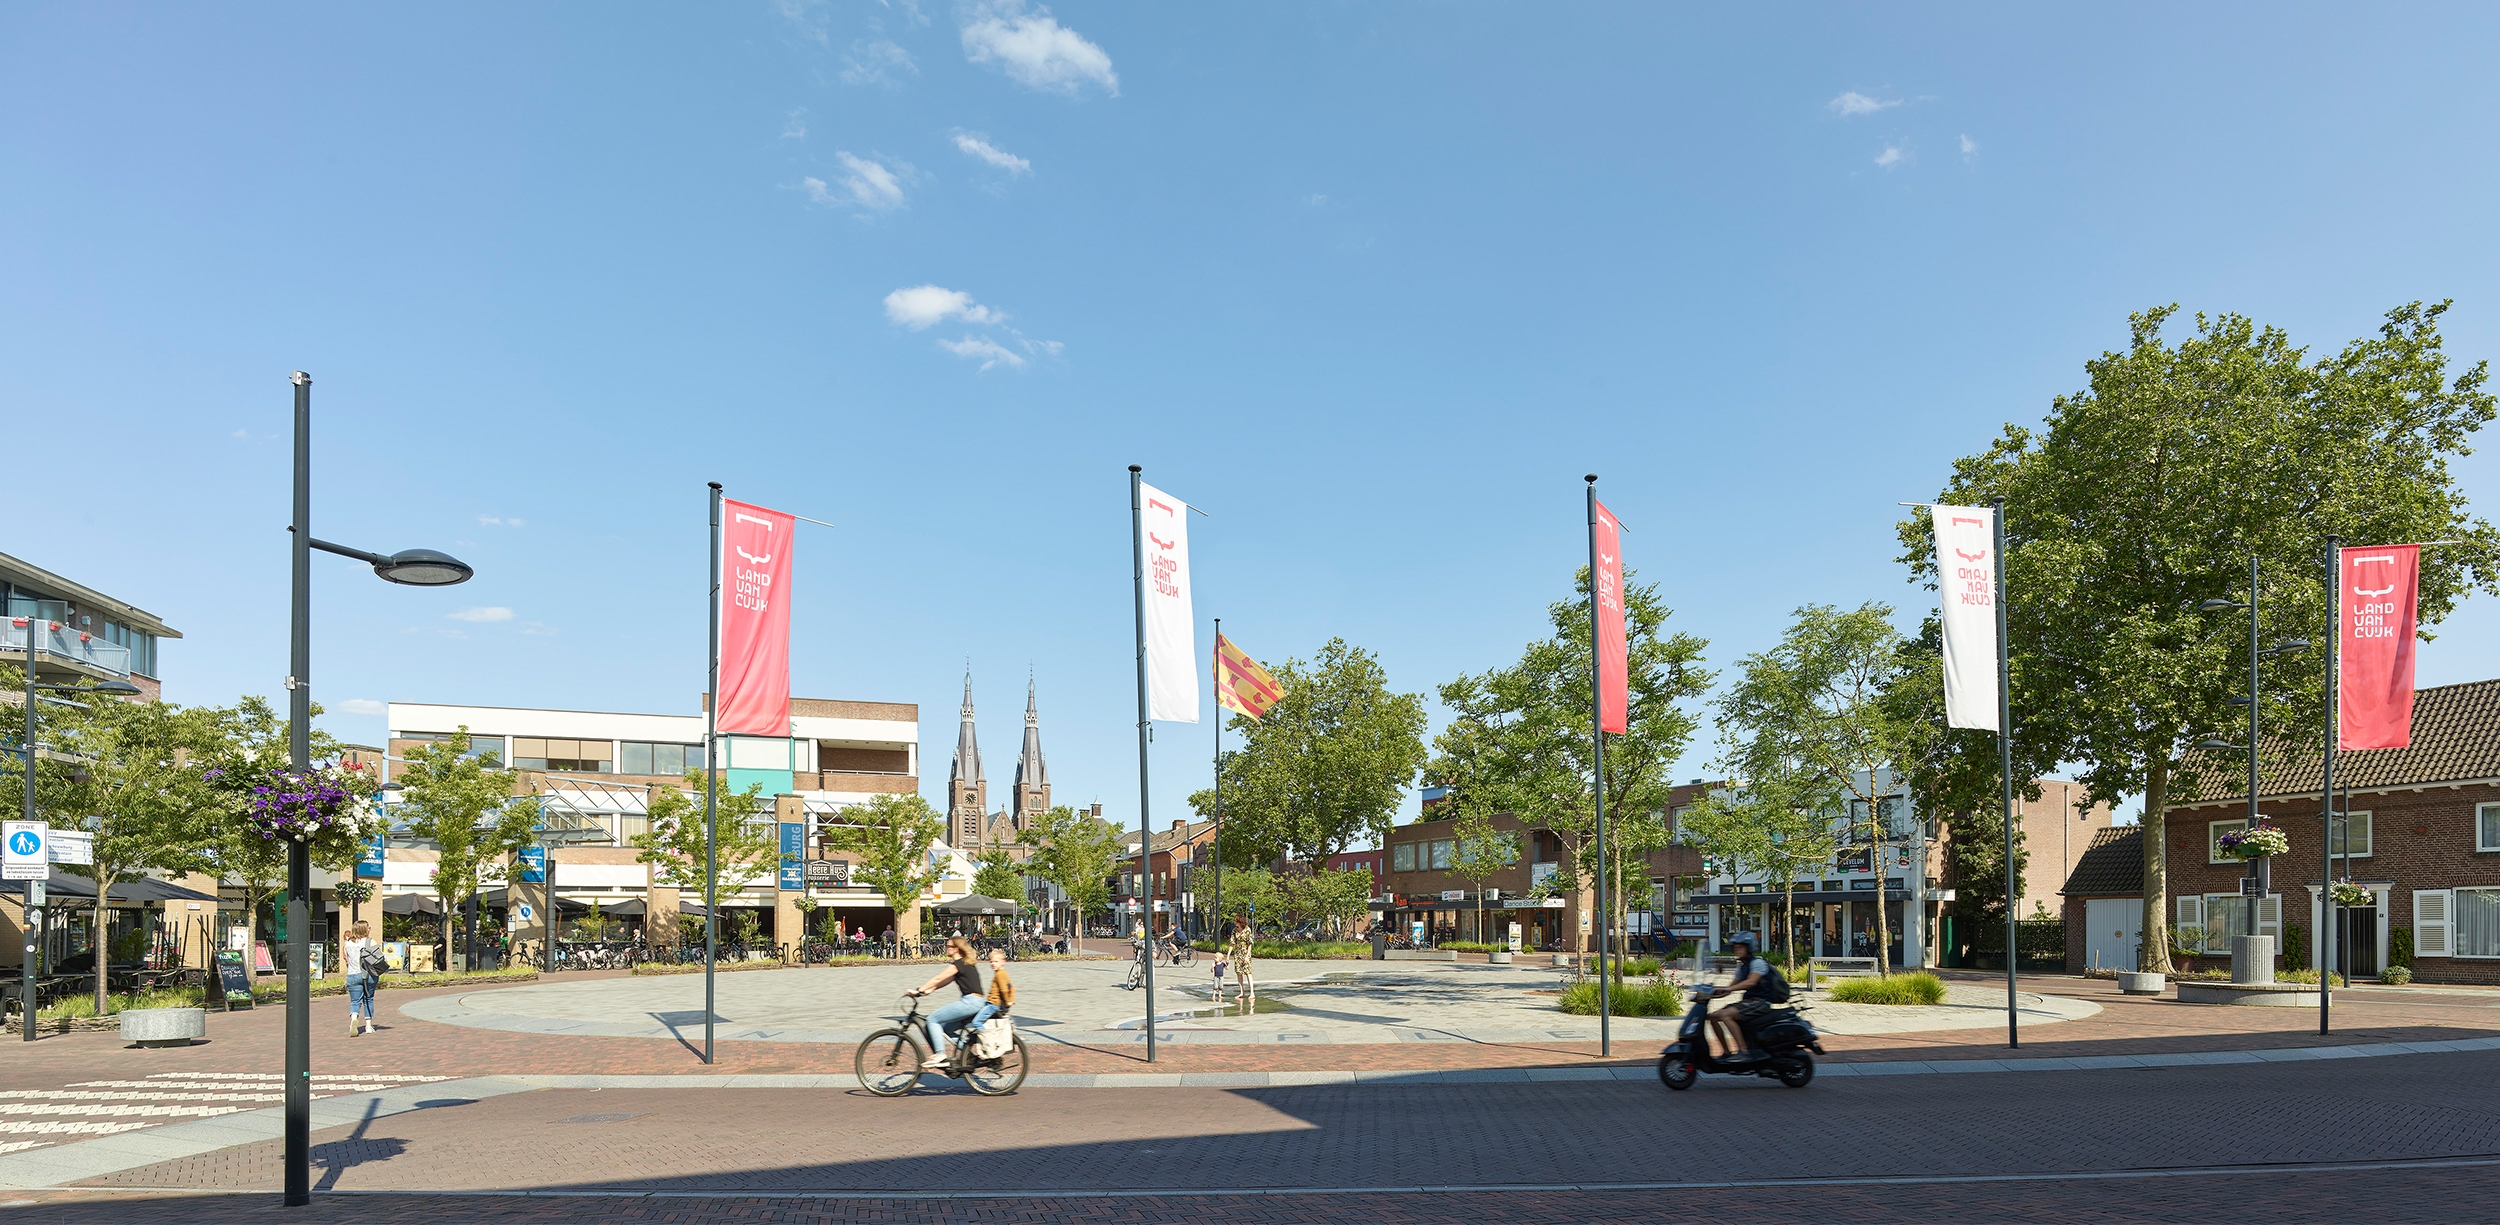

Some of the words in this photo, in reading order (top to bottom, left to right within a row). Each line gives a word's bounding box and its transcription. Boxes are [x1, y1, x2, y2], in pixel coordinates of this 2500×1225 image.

[1150, 552, 1177, 573] LAND
[736, 565, 771, 587] LAND
[1152, 565, 1171, 584] VAN
[736, 579, 760, 598] VAN
[735, 593, 769, 613] CUIJK
[2353, 602, 2395, 616] LAND
[2353, 614, 2384, 627] VAN
[2354, 625, 2394, 639] CUIJK
